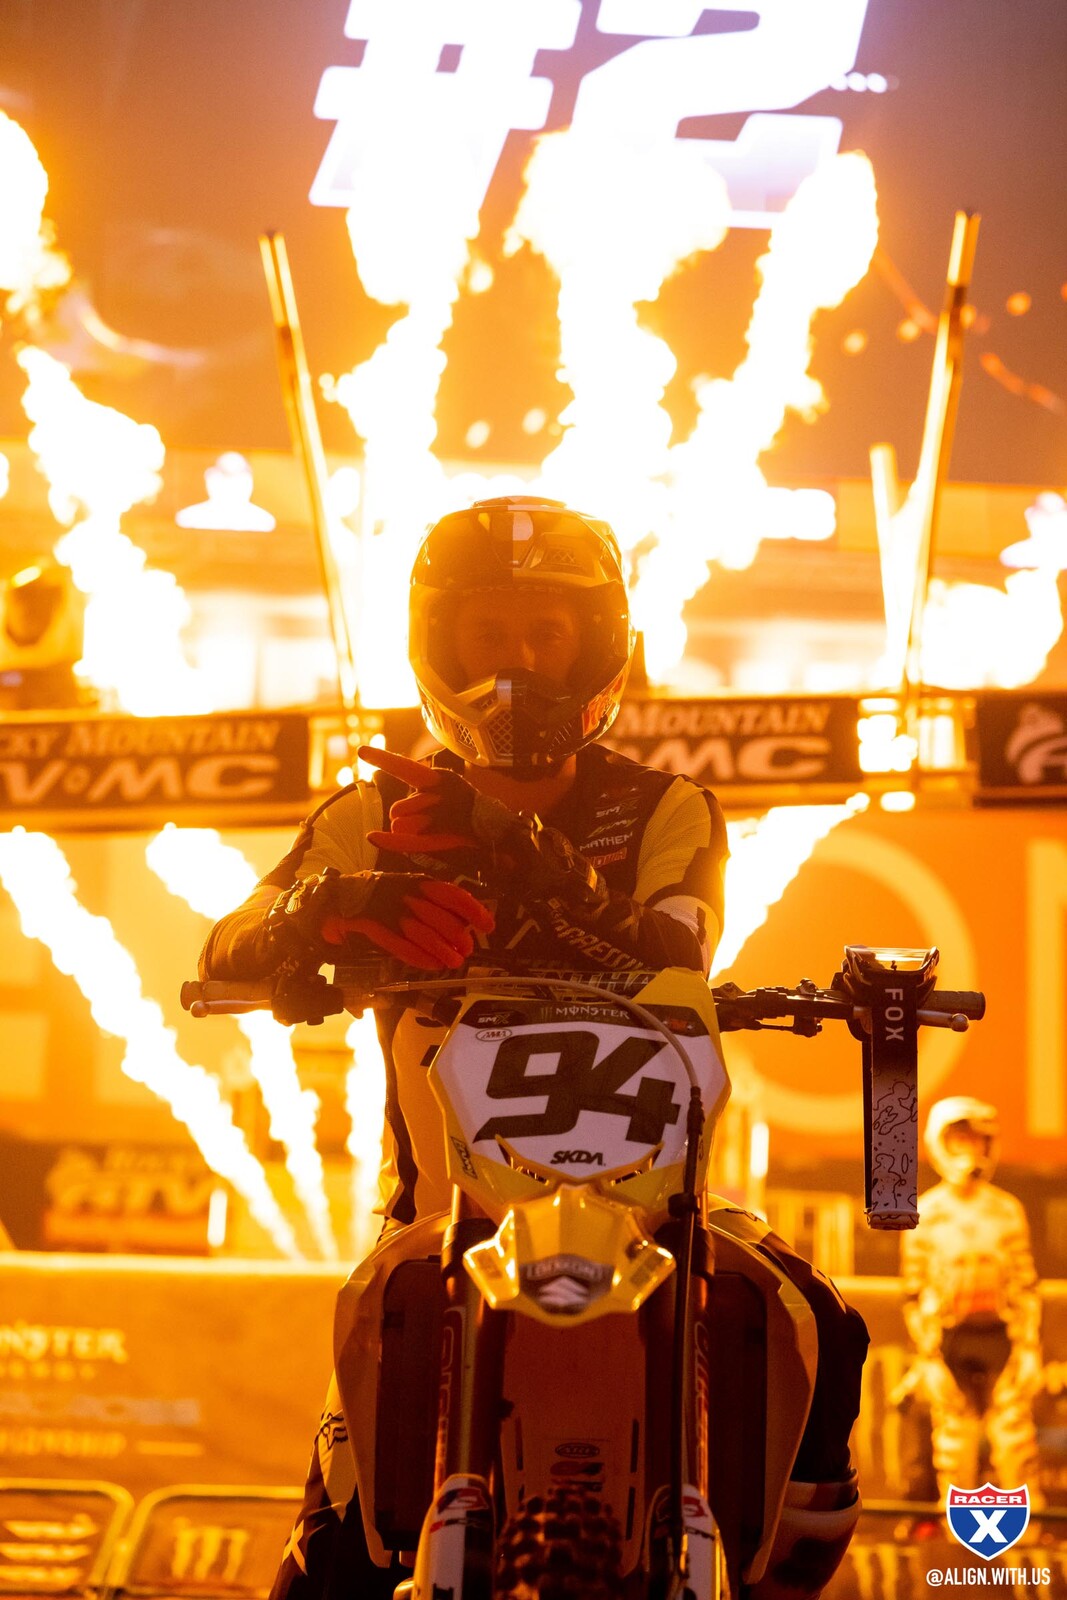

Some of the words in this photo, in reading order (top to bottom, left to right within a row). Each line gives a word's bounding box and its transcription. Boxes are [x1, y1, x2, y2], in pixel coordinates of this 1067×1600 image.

[64, 720, 281, 757] MOUNTAIN
[555, 1005, 631, 1020] MONSTER
[884, 988, 905, 1041] FOX
[472, 1030, 682, 1146] 94
